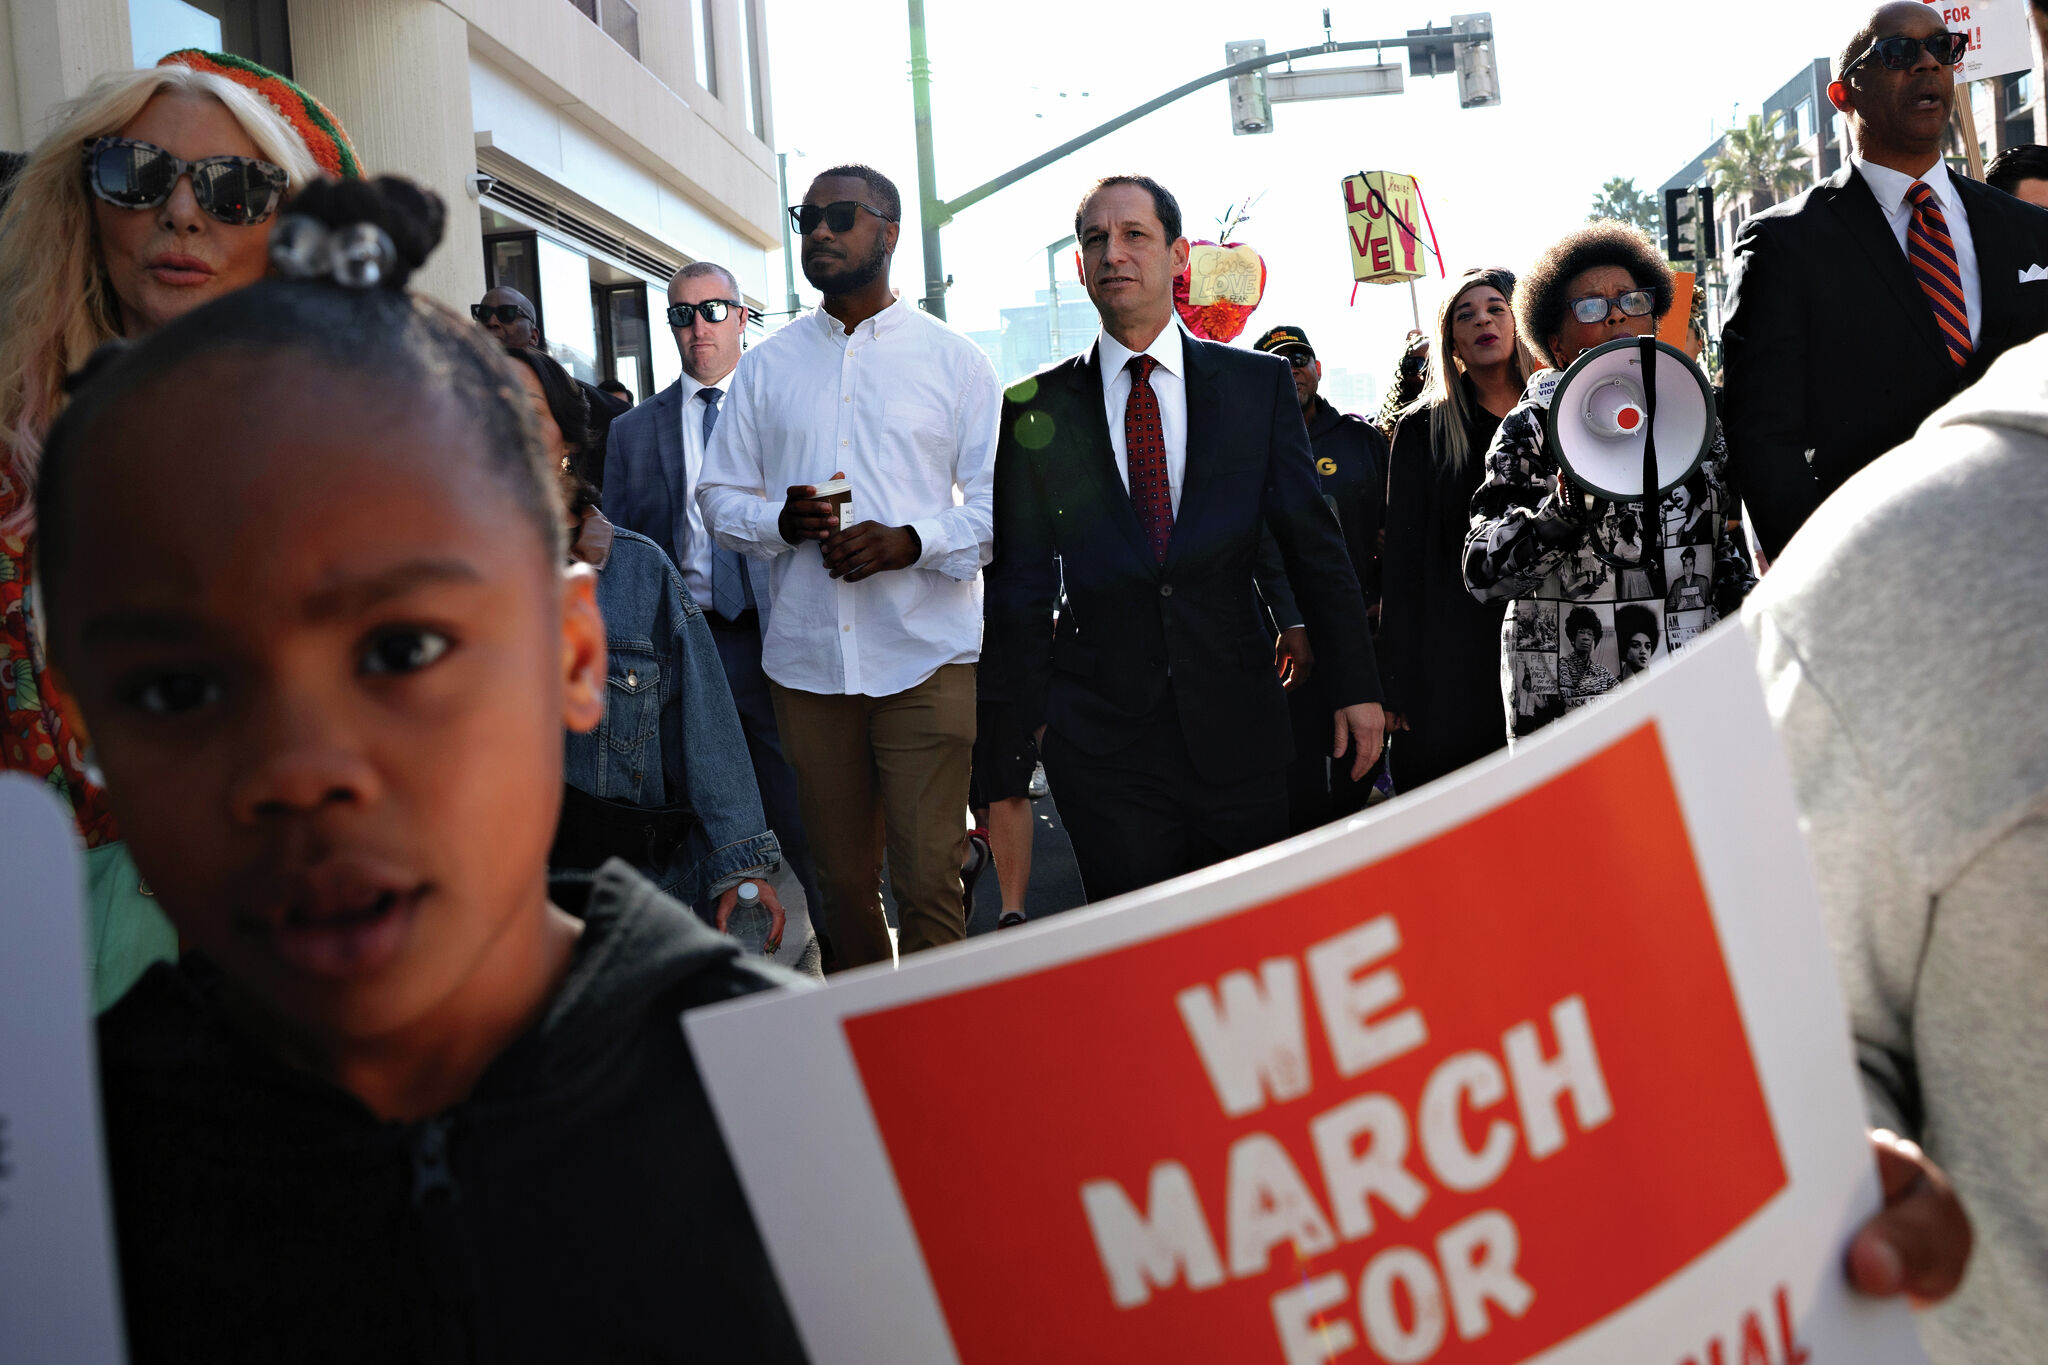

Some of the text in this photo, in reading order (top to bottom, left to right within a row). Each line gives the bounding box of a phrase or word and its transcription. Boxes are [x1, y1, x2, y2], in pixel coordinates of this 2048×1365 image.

[1943, 6, 1971, 25] FOR
[1199, 273, 1257, 299] LOVE
[1540, 380, 1556, 389] END
[1316, 457, 1338, 476] G
[1175, 912, 1430, 1119] WE
[1079, 993, 1615, 1312] MARCH
[1269, 1208, 1537, 1365] FOR
